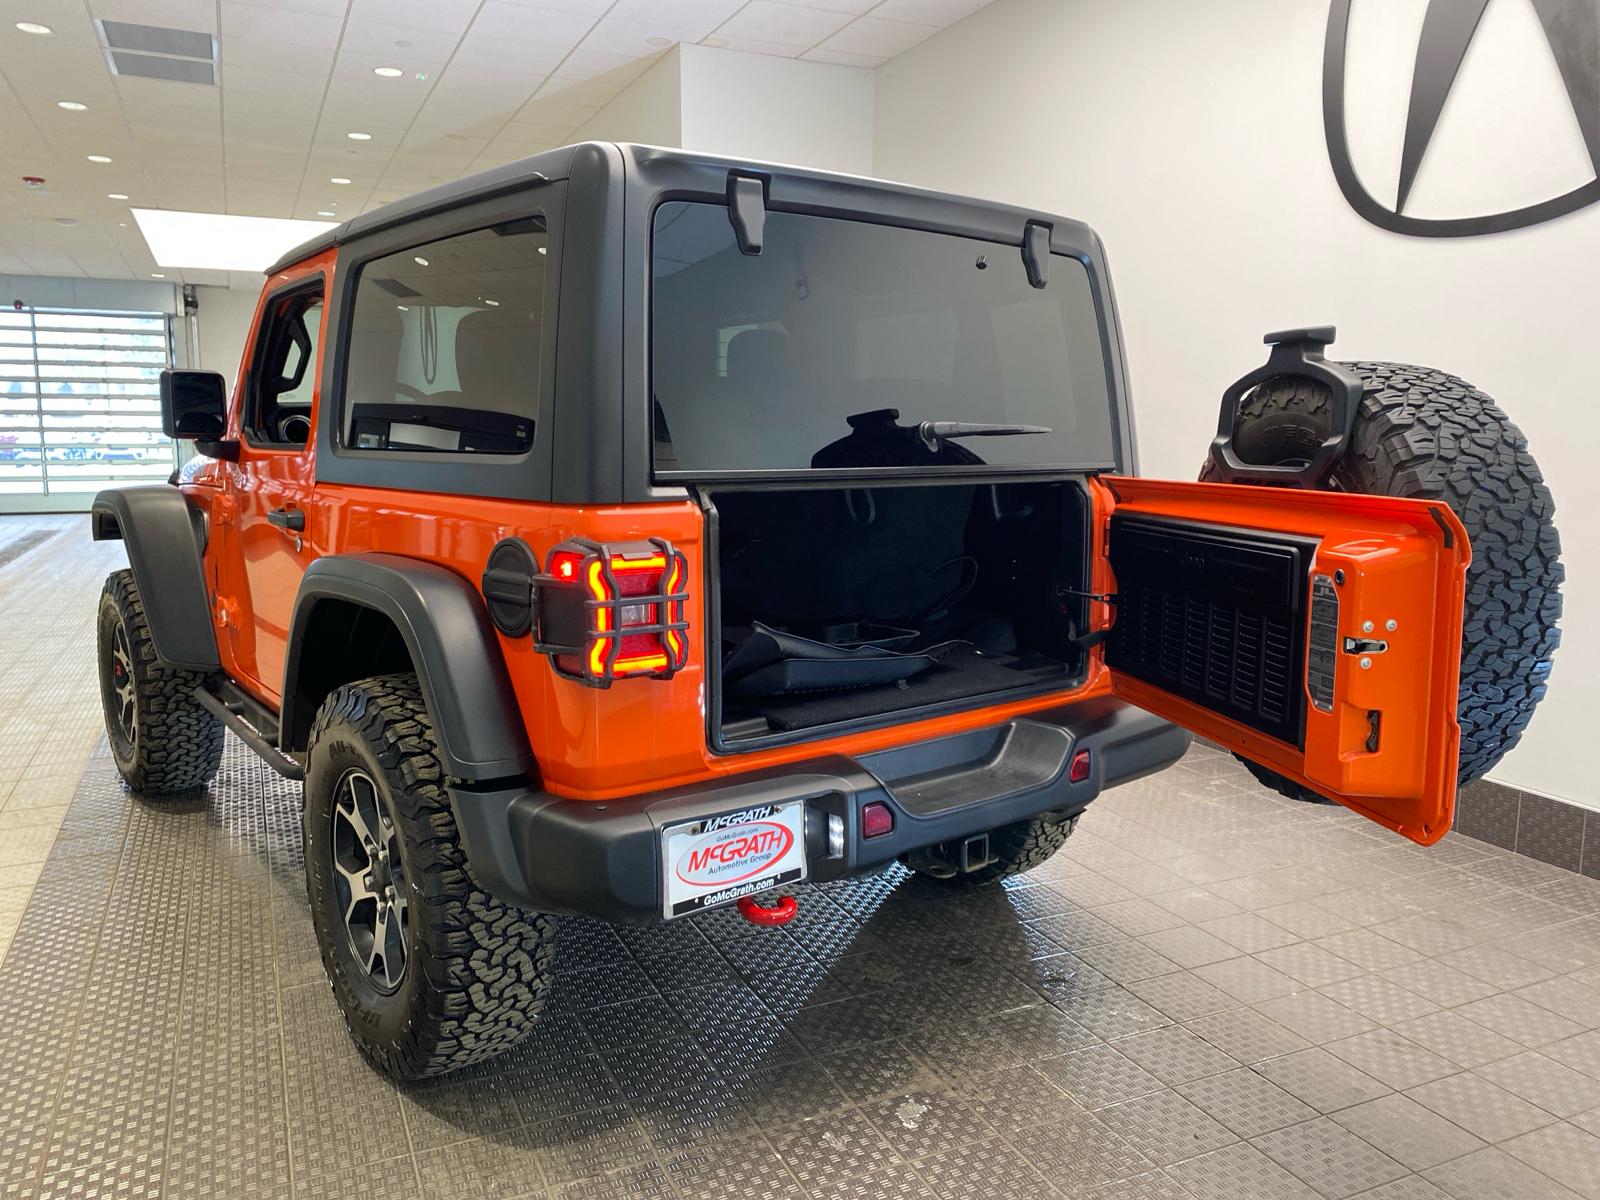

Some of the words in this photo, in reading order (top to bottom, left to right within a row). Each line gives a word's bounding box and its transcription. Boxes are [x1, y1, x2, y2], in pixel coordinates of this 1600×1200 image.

[1181, 551, 1205, 574] Jeep
[716, 827, 759, 843] GoMcGrath.com
[707, 858, 749, 876] Automotive
[749, 852, 772, 865] Group
[703, 878, 775, 906] GoMcGrath.com
